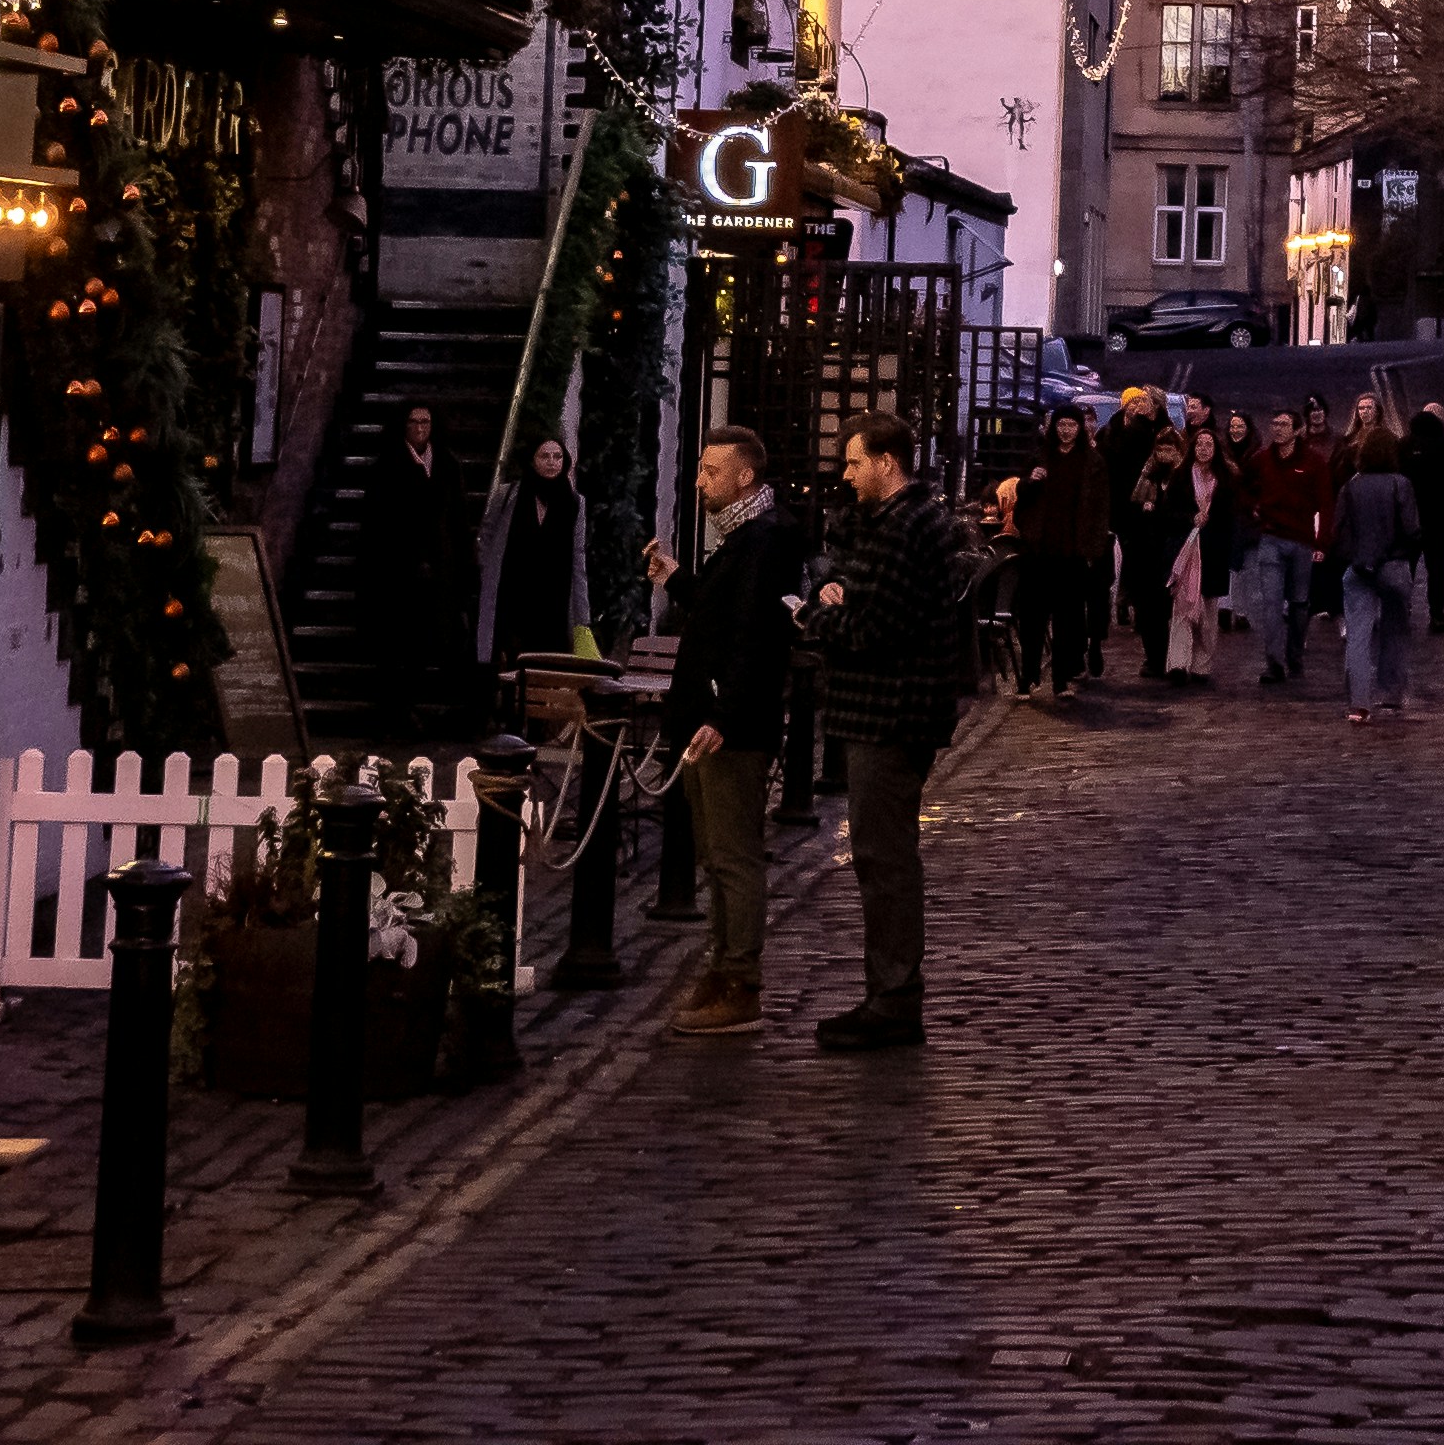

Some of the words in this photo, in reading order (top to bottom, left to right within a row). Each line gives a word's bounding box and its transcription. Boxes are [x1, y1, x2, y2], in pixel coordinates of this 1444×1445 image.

[700, 125, 777, 206] G
[712, 214, 794, 229] GARDENER
[805, 223, 837, 235] THE
